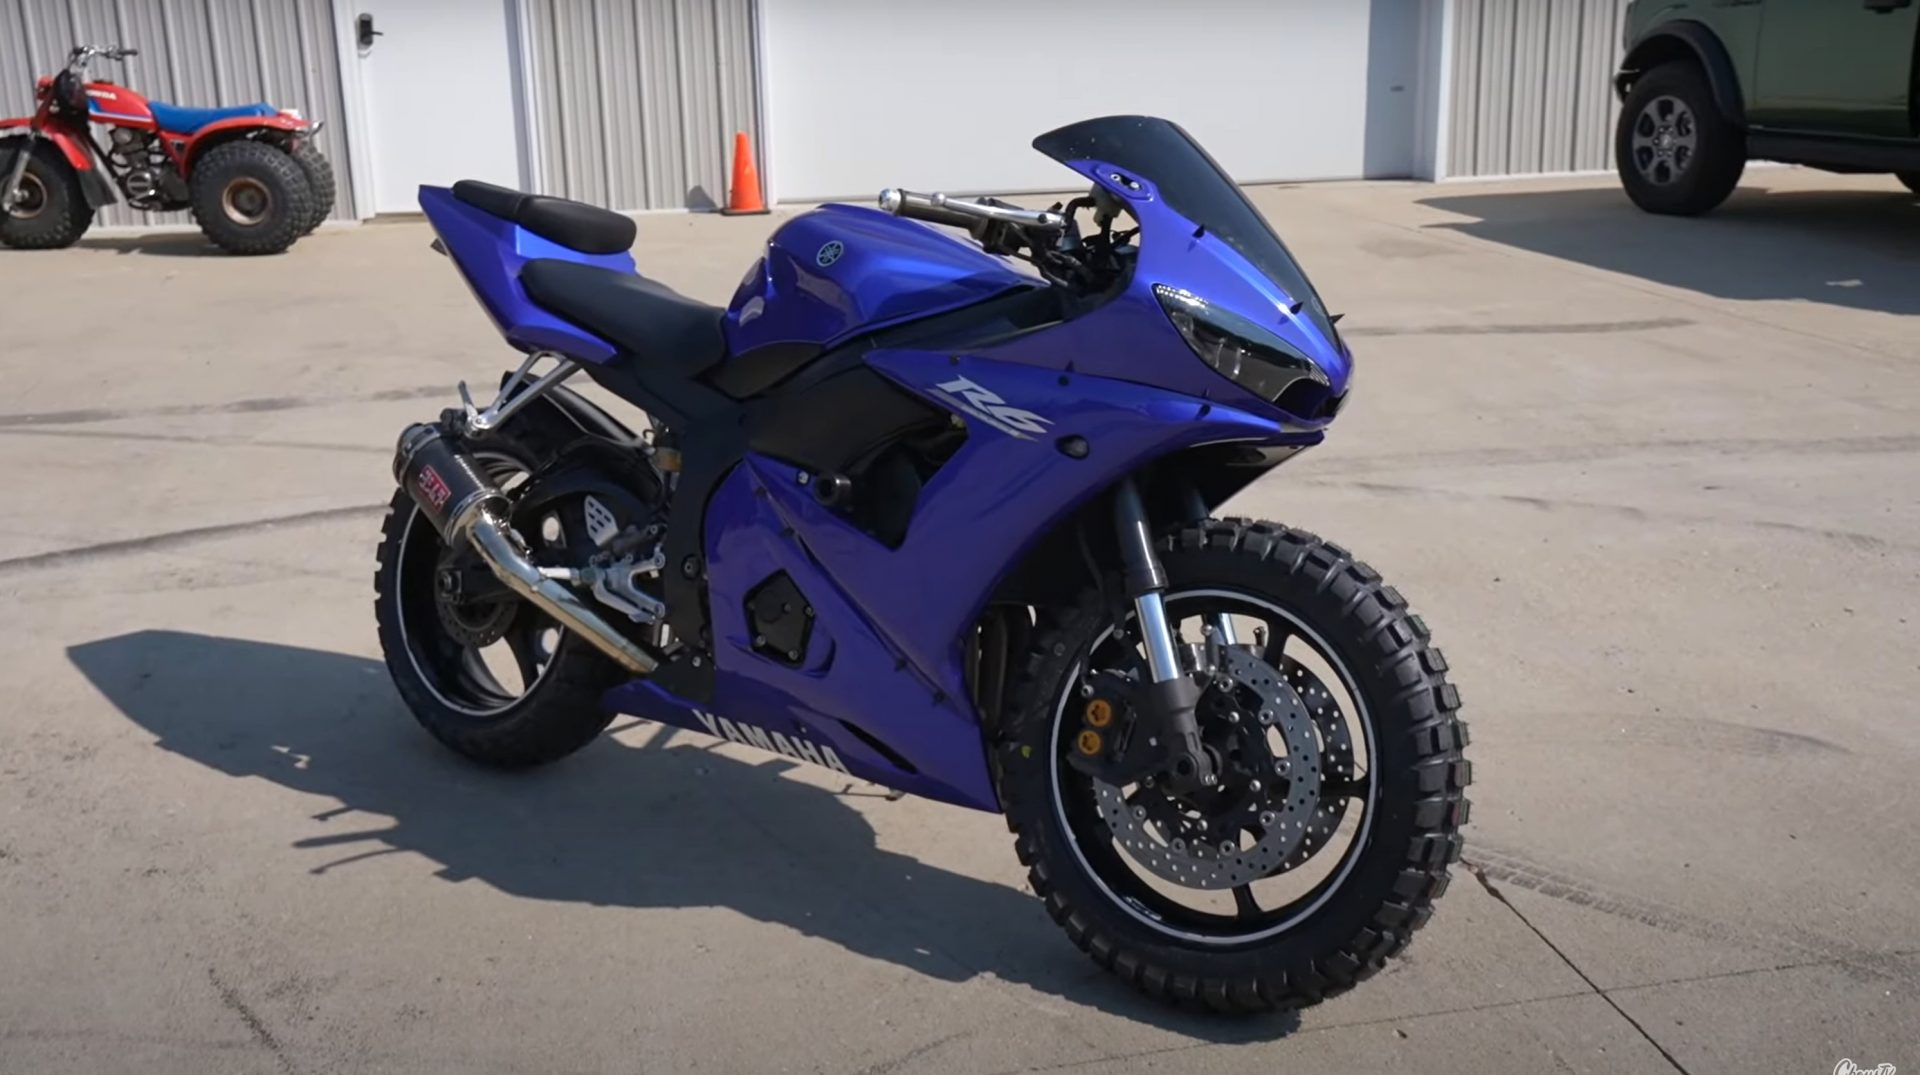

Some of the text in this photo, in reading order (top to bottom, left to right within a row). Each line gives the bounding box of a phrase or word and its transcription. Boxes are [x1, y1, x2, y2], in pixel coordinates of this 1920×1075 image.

[86, 89, 117, 100] ONDA
[935, 375, 1055, 433] R6
[691, 708, 850, 775] YAMAHA
